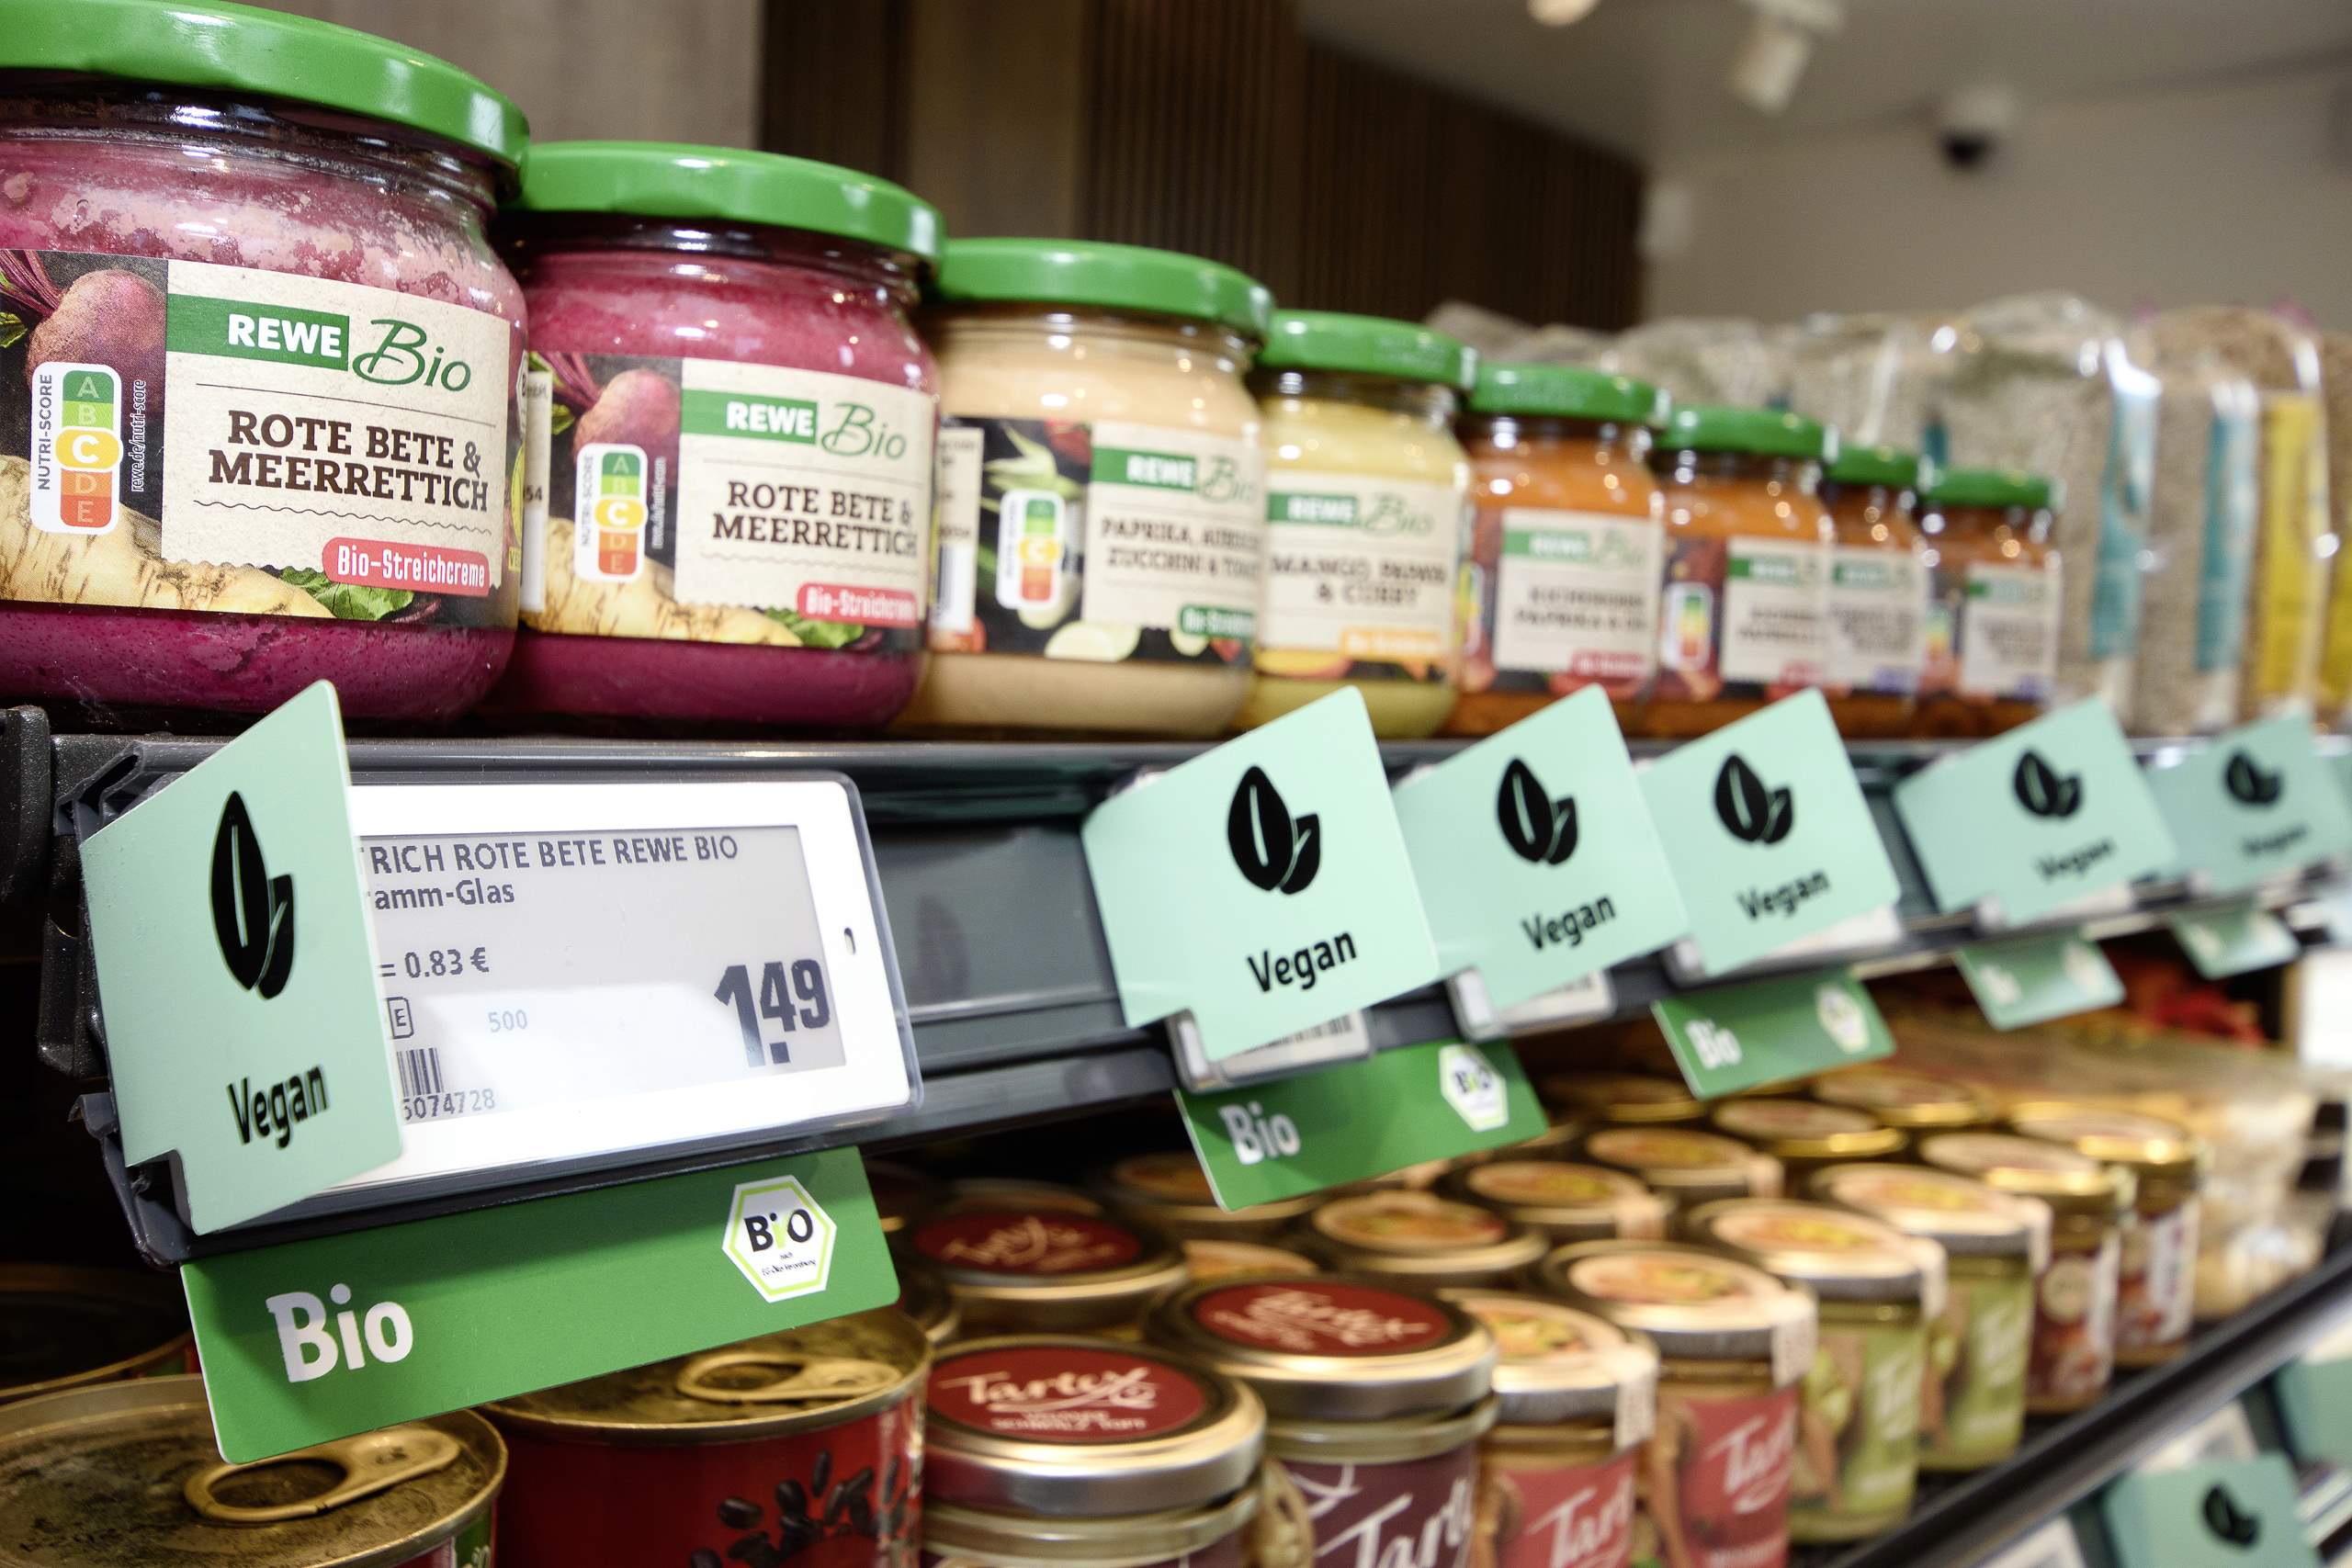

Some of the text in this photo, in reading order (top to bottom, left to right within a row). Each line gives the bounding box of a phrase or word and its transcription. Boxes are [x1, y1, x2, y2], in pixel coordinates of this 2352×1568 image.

[228, 314, 472, 392] REWE Bio
[77, 376, 100, 398] A
[38, 374, 52, 491] NUTRI-SCORE
[77, 403, 96, 425] B
[129, 379, 146, 491] rewe.de/nutri-score
[726, 400, 907, 460] REWE Bio
[73, 434, 99, 464] C
[228, 410, 481, 473] ROTE BETE &
[75, 474, 97, 496] D
[209, 449, 489, 513] MEERRETTICH
[613, 455, 629, 474] A
[77, 500, 94, 523] E
[607, 502, 629, 526] C
[727, 480, 820, 514] ROTE
[831, 491, 894, 523] BETE
[712, 513, 918, 558] MEERRETTICH
[336, 544, 486, 590] Bio-Streichcreme
[361, 834, 739, 874] RICH ROTE BETE REWE BIO
[368, 878, 515, 910] amm-Glas
[1736, 869, 1832, 922] Vegan
[1521, 895, 1617, 951] Vegan
[404, 948, 464, 980] 0.83
[469, 946, 491, 974] €
[1247, 931, 1358, 993] Vegan
[394, 1008, 407, 1027] E
[488, 1009, 528, 1033] 500
[228, 1065, 331, 1150] Vegan
[1219, 1101, 1301, 1166] Bio
[266, 1283, 414, 1383] Bio
